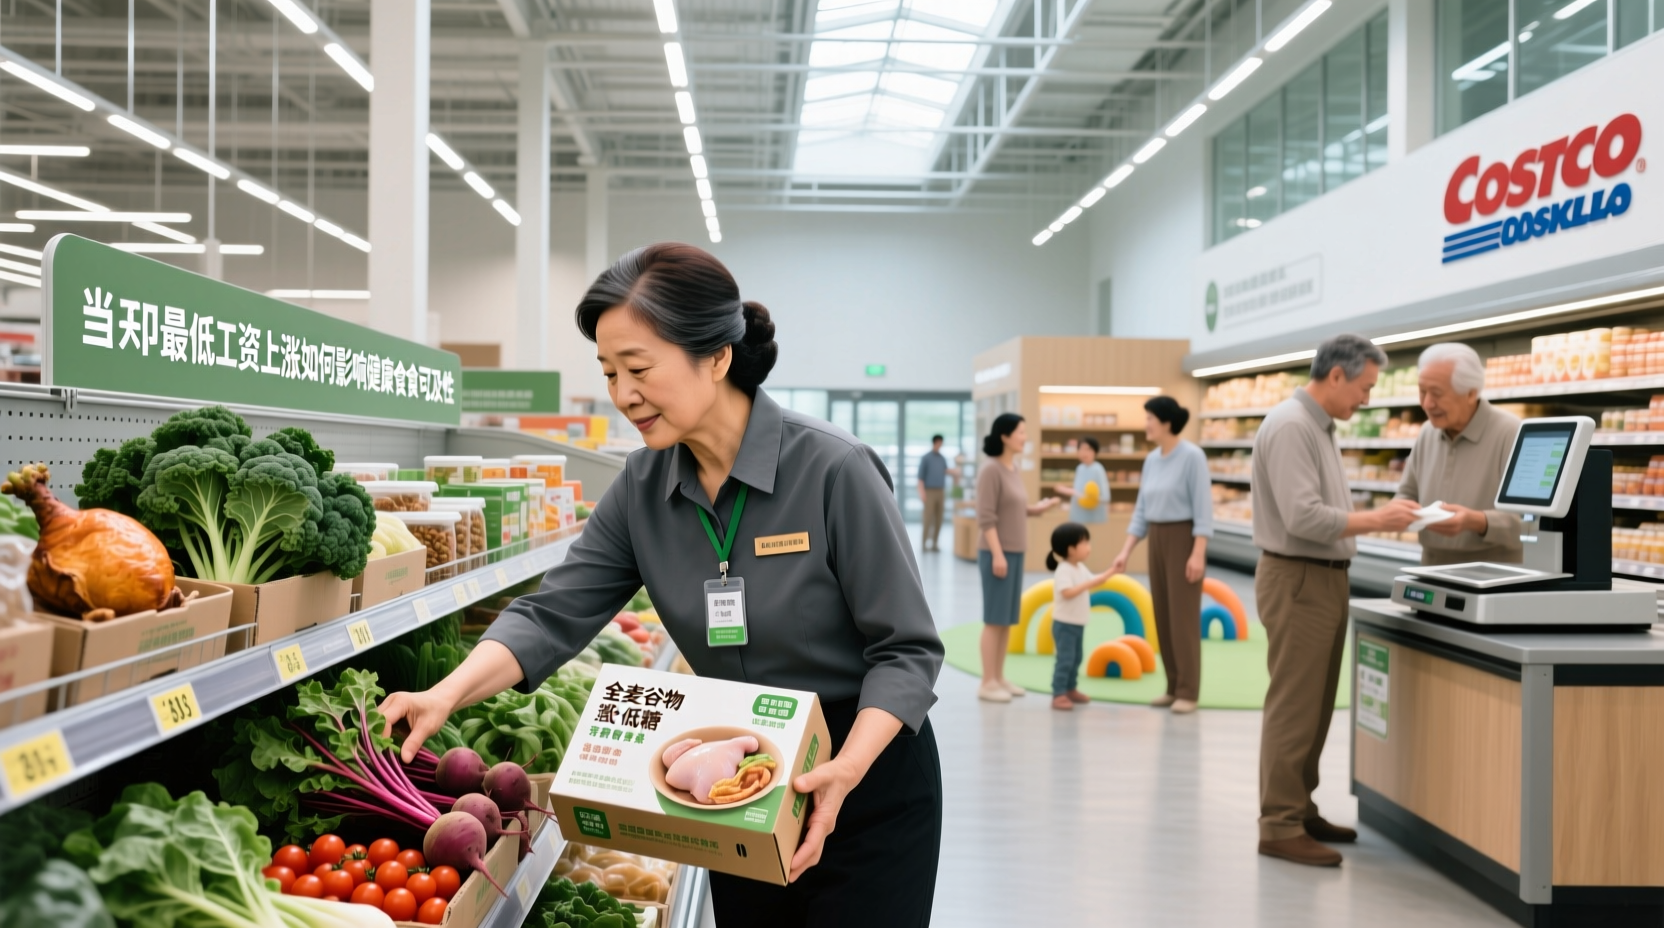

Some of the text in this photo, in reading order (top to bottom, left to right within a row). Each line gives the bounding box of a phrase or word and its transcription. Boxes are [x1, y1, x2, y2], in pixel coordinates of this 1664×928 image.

[1444, 113, 1642, 225] COSTCO
[603, 681, 686, 712] 全麦谷物
